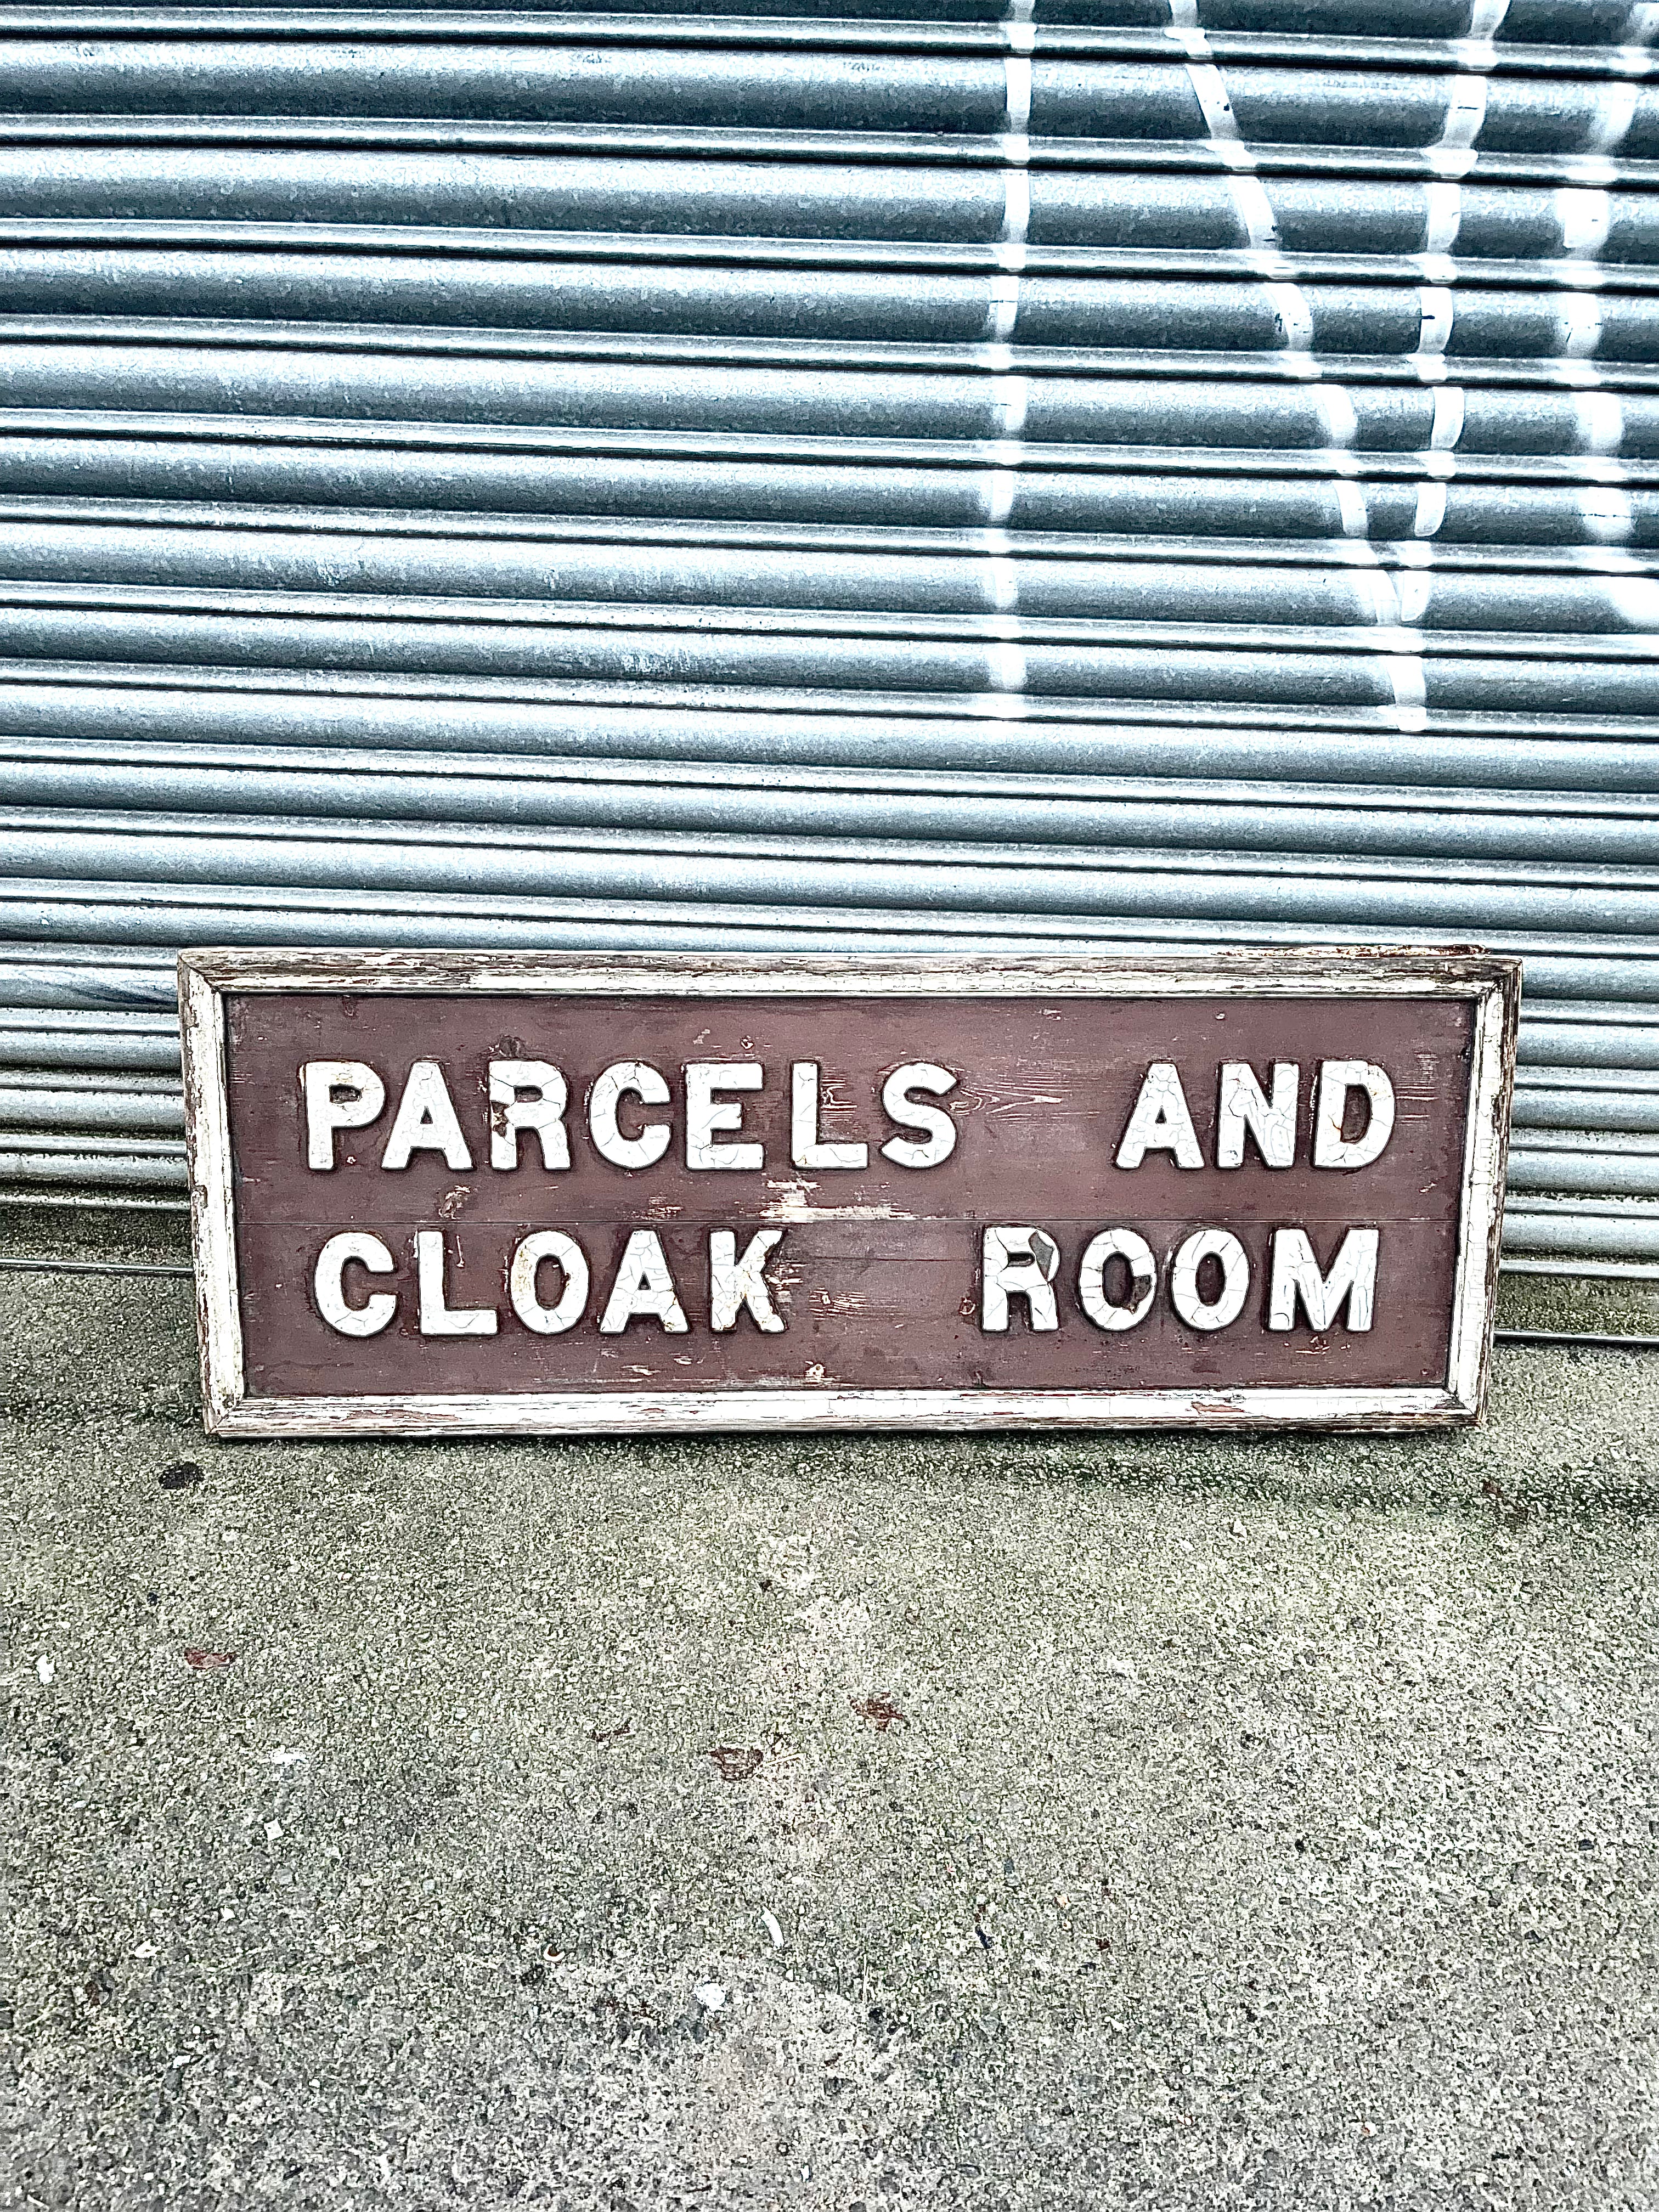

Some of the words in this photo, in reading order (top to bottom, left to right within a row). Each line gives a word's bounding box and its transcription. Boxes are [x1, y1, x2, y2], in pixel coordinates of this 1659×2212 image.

[299, 1059, 959, 1171] PARCELS
[1114, 1059, 1396, 1170] AND
[313, 1228, 788, 1338] CLOAK
[981, 1226, 1380, 1333] ROOM
